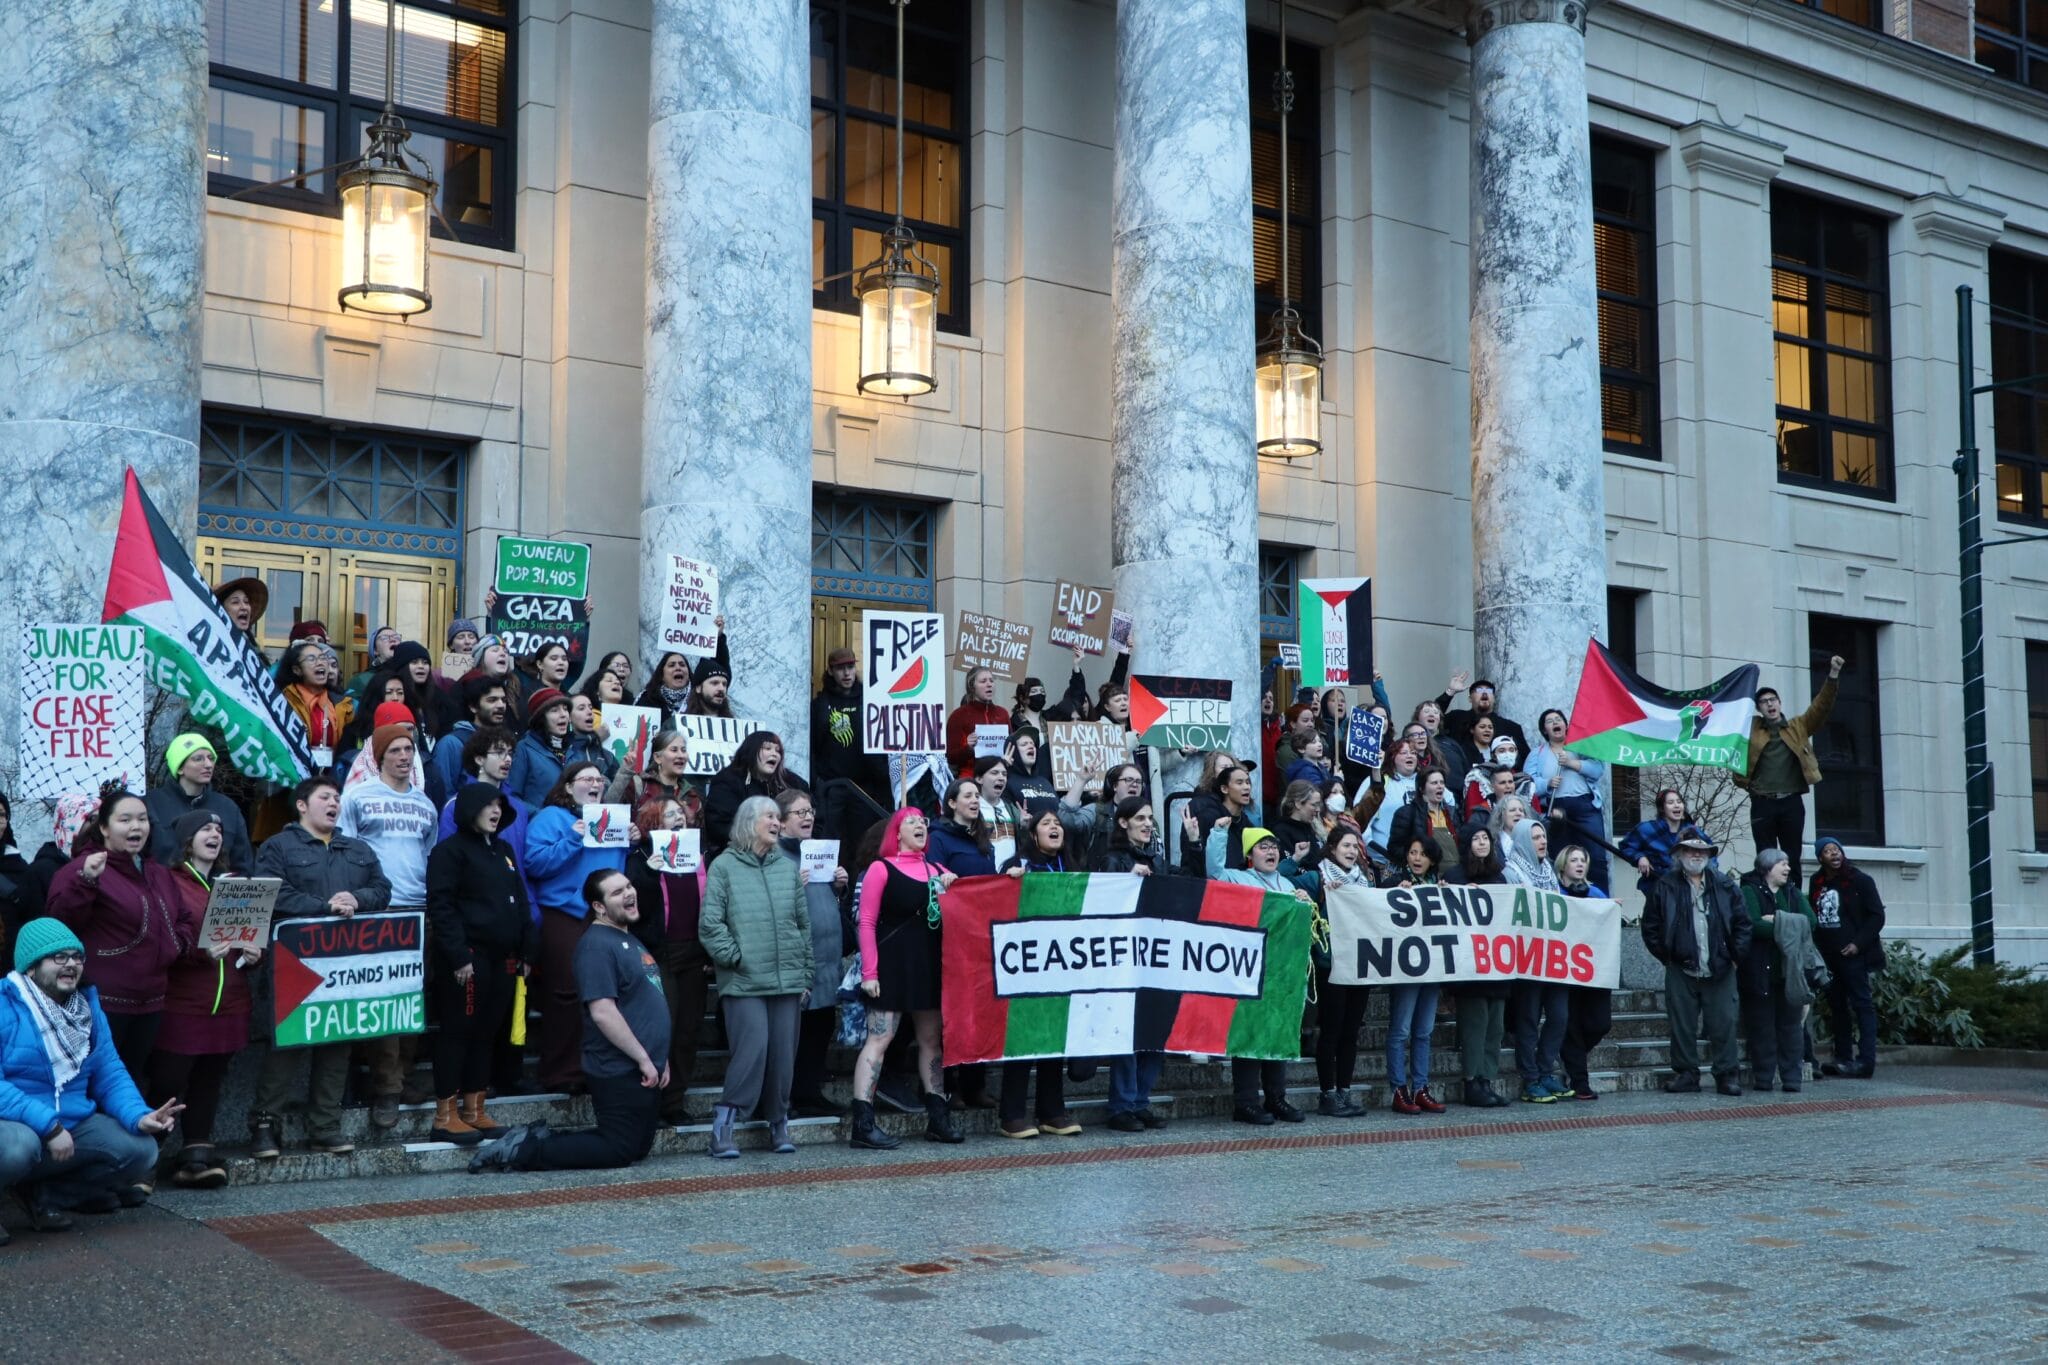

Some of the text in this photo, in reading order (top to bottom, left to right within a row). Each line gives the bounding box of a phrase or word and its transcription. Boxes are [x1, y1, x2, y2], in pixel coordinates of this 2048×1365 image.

[511, 544, 575, 564] JUNEAU
[673, 555, 700, 573] THERE
[532, 567, 577, 587] 31,405
[674, 572, 704, 588] IS NO
[669, 584, 713, 603] NEUTRAL
[1058, 582, 1102, 615] END
[506, 596, 574, 622] GAZA
[672, 598, 712, 616] STANCE
[497, 619, 527, 631] KILLED
[531, 620, 553, 631] SINCE
[676, 613, 698, 626] IN A
[964, 613, 1030, 636] FROM THE RIVER
[1066, 611, 1085, 627] THE
[664, 628, 717, 649] GENOCIDE
[974, 624, 1013, 640] TO THE SEA
[1051, 626, 1103, 651] OCCUPATION
[29, 627, 137, 662] JUNEAU
[869, 618, 939, 688] FREE
[960, 631, 1028, 661] PALESTINE
[963, 653, 1010, 671] WILL BE FREE
[1325, 647, 1347, 666] FIRE
[55, 662, 107, 691] FOR
[1325, 667, 1350, 683] NOW
[1158, 677, 1230, 698] CEASE
[32, 694, 115, 729] CEASE
[1169, 699, 1230, 724] FIRE
[1351, 712, 1382, 733] CEASE
[866, 702, 946, 752] PALESTINE
[1052, 724, 1125, 746] ALASKA FOR
[1165, 725, 1231, 750] NOW
[50, 727, 113, 758] FIRE
[1052, 744, 1127, 772] PALESTINE
[1616, 743, 1742, 770] PALESTINE
[216, 891, 263, 900] POPULATION
[217, 882, 267, 893] JUNEAU'S
[209, 906, 269, 917] DEATH TOLL
[1386, 887, 1569, 932] SEND AID
[209, 918, 220, 926] IN
[224, 917, 251, 926] GAZA
[299, 918, 416, 956] JUNEAU
[1000, 935, 1259, 978] CEASEFIRE NOW
[1357, 933, 1595, 983] NOT BOMBS
[325, 962, 423, 989] STANDS WITH
[304, 993, 424, 1041] PALESTINE
